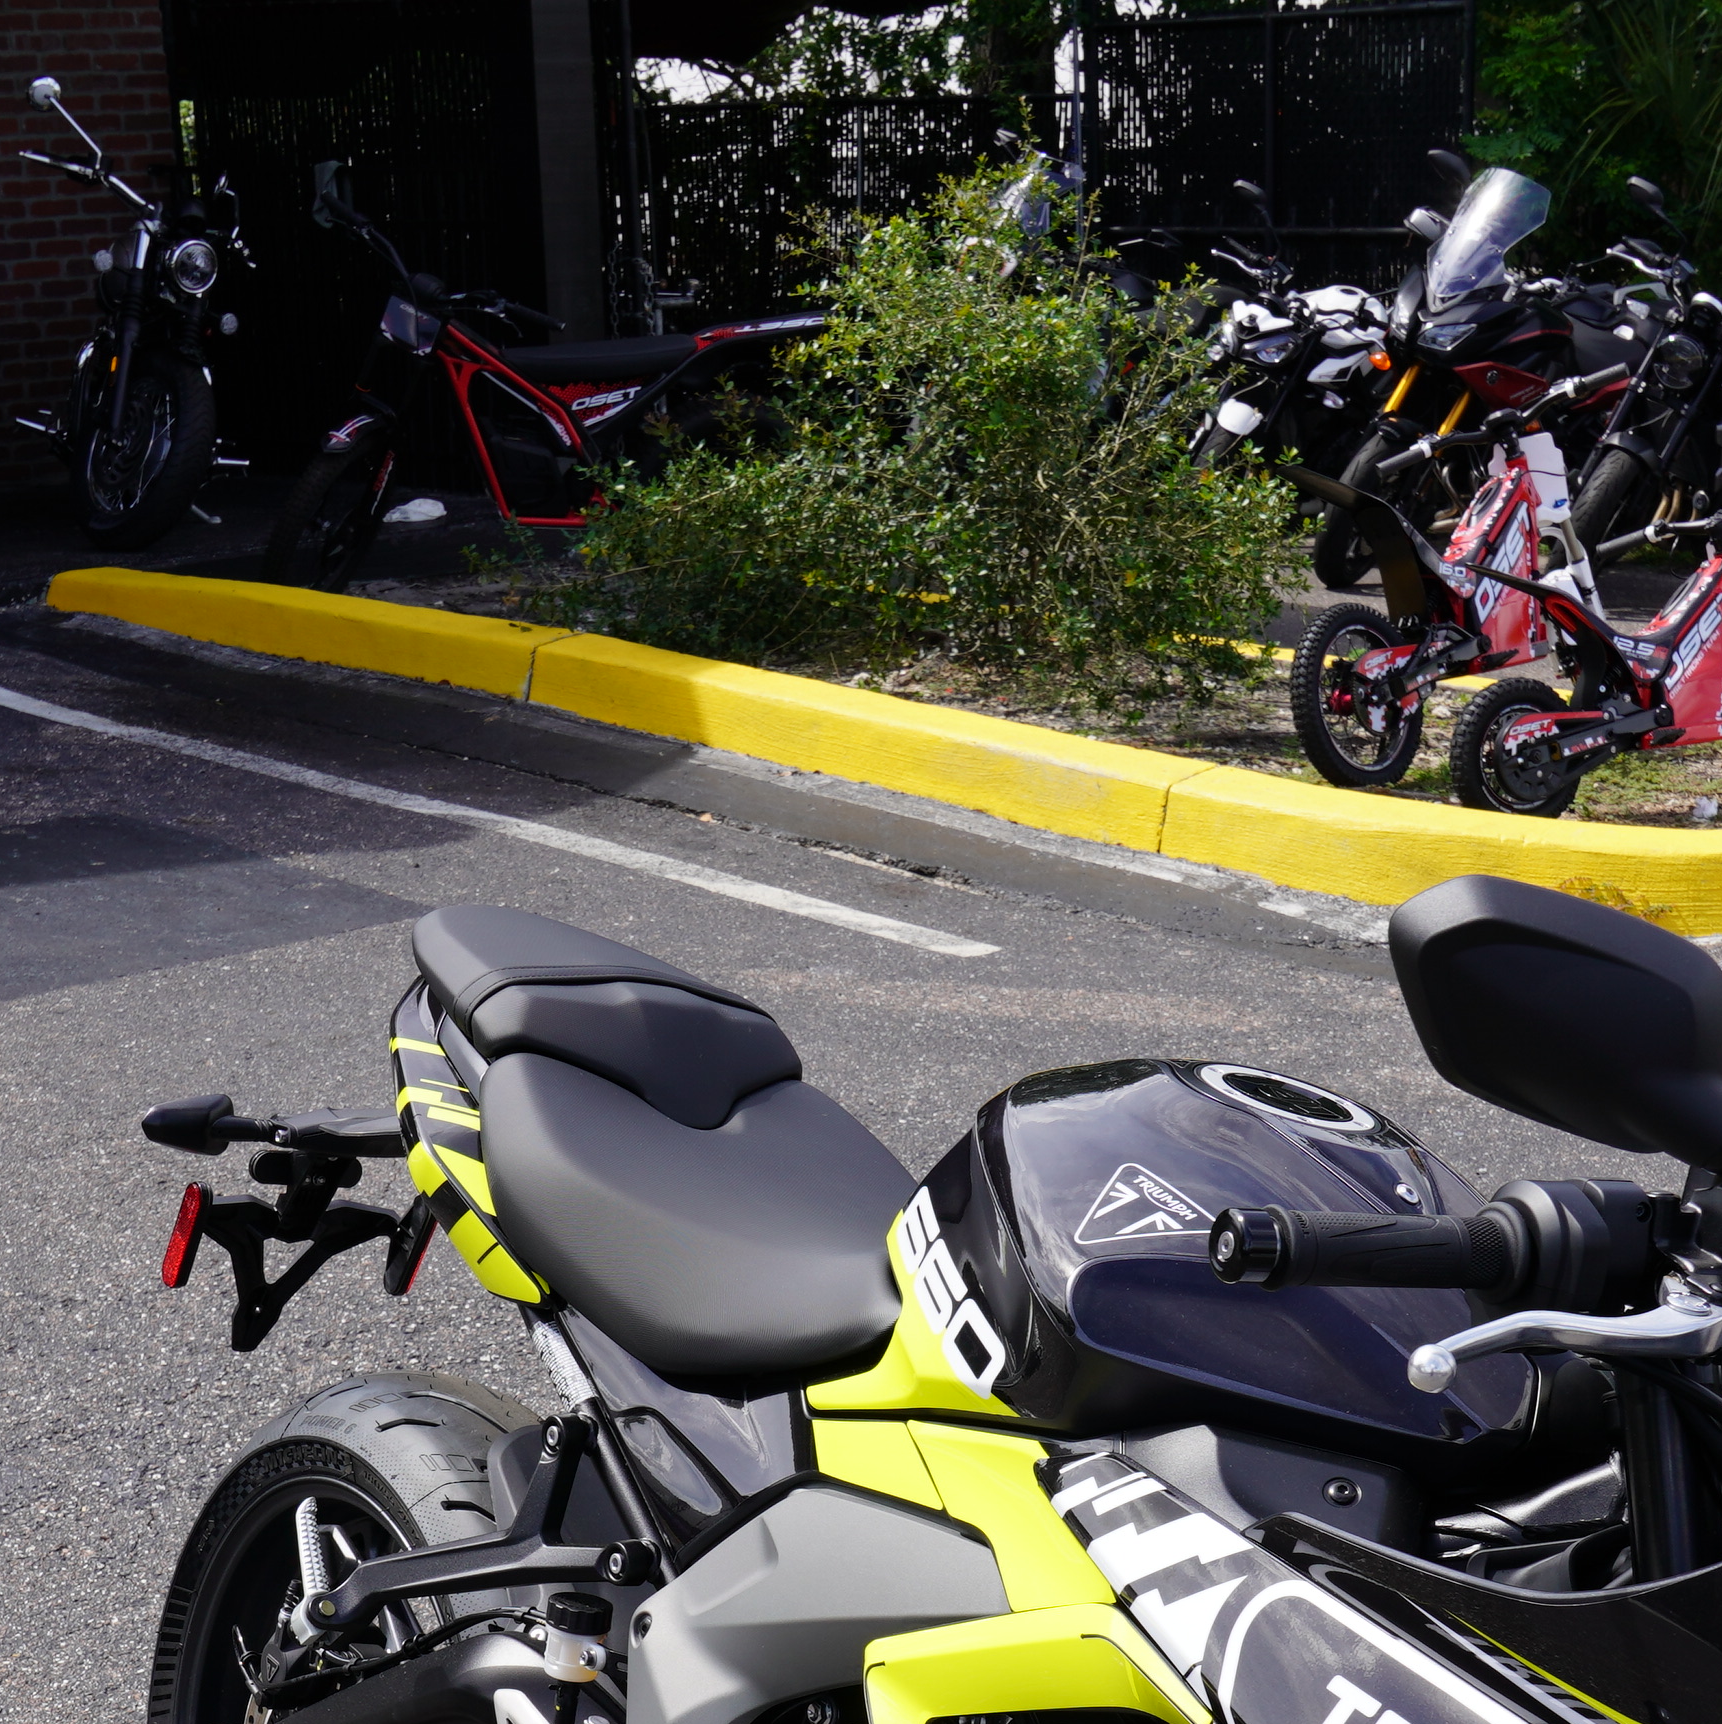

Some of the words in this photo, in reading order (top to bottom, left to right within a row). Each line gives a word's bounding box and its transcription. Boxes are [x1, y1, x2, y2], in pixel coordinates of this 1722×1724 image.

[571, 386, 641, 410] OSET
[1509, 719, 1551, 736] OSET
[1132, 1175, 1197, 1221] TRIUMPH
[896, 1185, 1006, 1399] 660
[300, 1414, 346, 1432] POWER
[263, 1444, 338, 1472] MICHELIN
